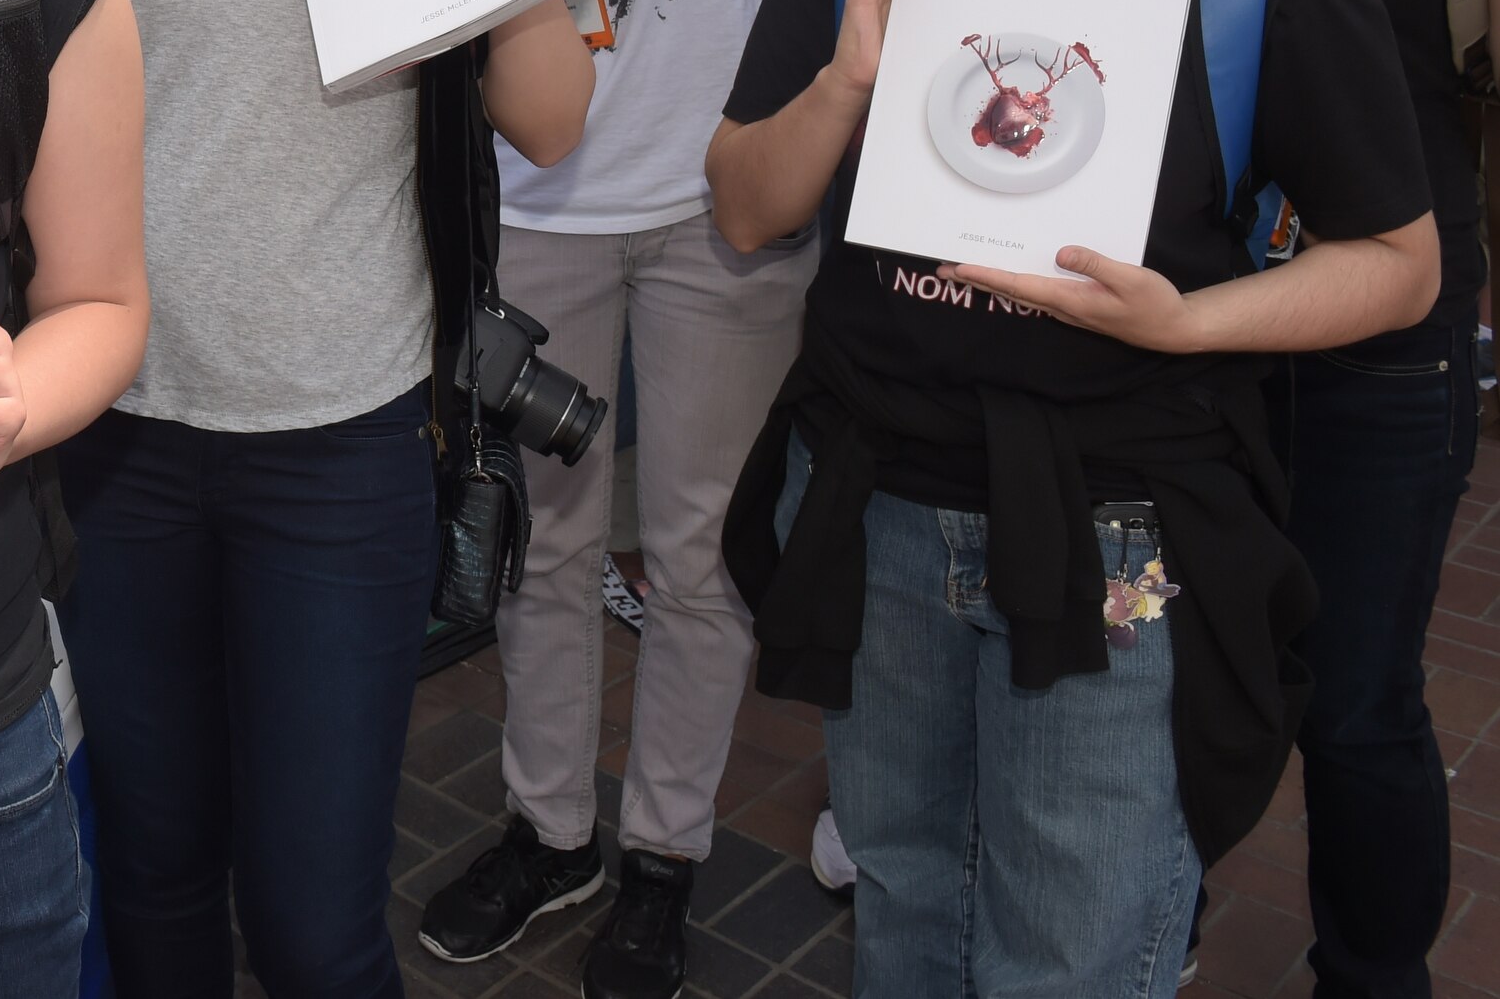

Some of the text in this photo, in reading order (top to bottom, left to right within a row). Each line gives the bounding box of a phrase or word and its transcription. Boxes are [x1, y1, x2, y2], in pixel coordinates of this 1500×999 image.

[420, 10, 445, 23] JESSE
[958, 233, 1025, 250] JESSE McLEAN
[893, 267, 973, 309] NOM
